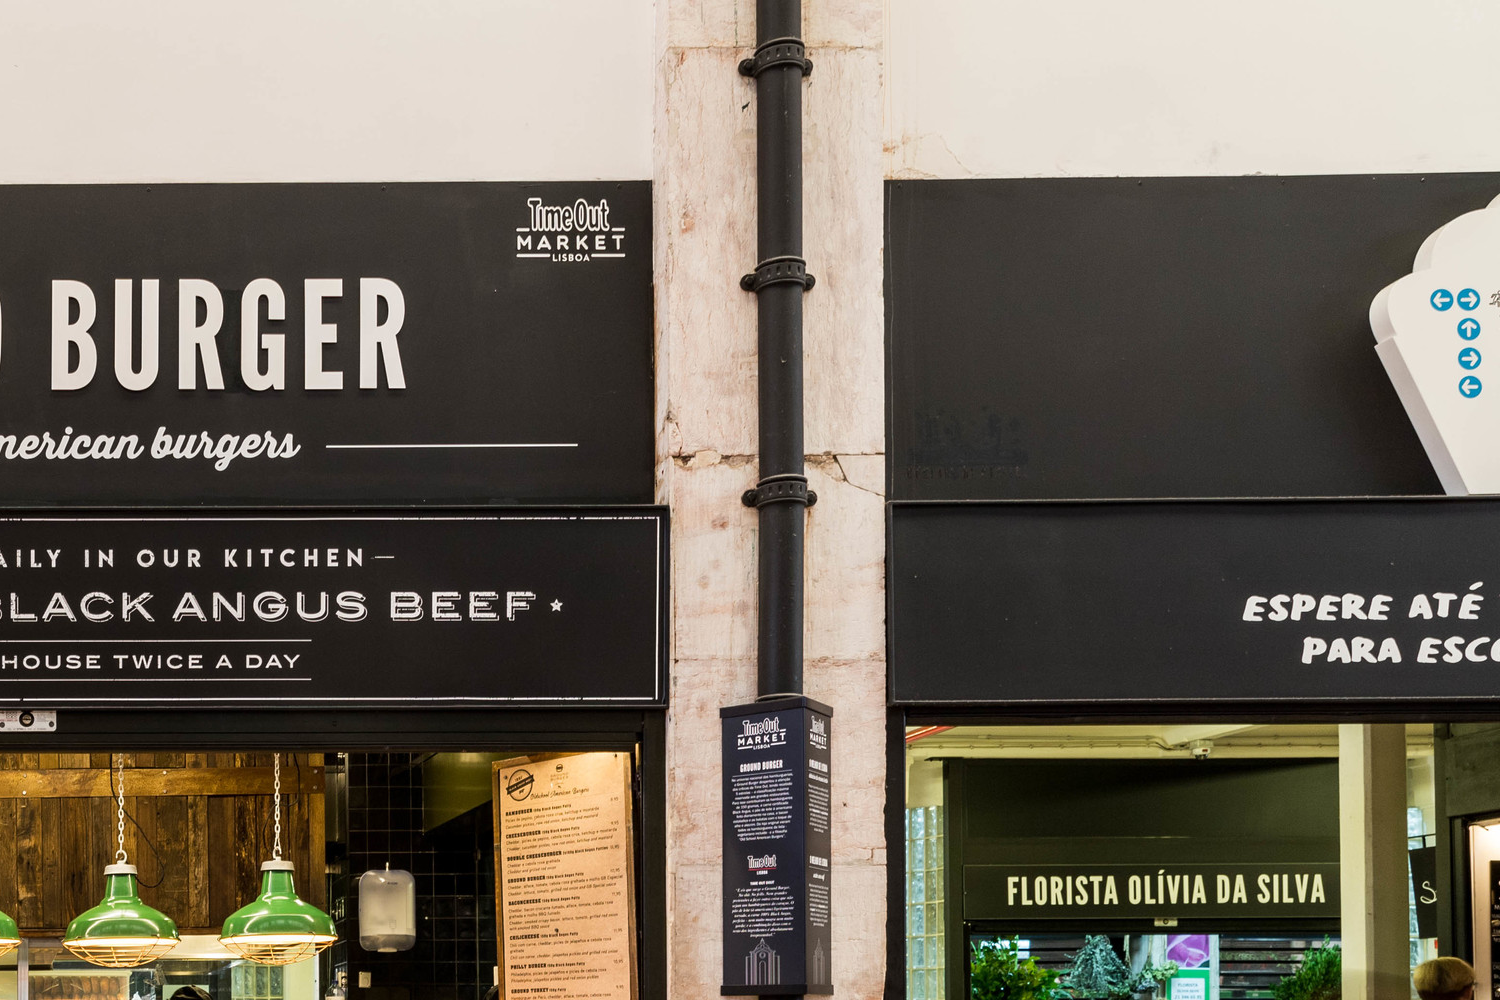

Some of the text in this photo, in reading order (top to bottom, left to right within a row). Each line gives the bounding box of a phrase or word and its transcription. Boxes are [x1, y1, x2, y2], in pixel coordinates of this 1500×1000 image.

[516, 235, 625, 251] MARKET
[552, 254, 591, 262] LISBOA
[50, 276, 407, 392] BURGER
[148, 426, 302, 472] burgers
[84, 549, 115, 568] IN
[136, 549, 202, 568] OUR
[224, 548, 364, 568] KITCHEN
[172, 590, 368, 622] ANGUS
[389, 591, 537, 622] BEEF
[1242, 581, 1484, 622] ESPERE ATÉ
[0, 653, 101, 670] HOUSE
[113, 653, 204, 670] TWICE
[215, 653, 234, 669] A
[245, 653, 301, 669] DAY
[1301, 636, 1402, 664] PARA
[737, 732, 787, 747] MARKET
[740, 759, 784, 773] GROUND BURGER
[1007, 869, 1326, 906] FLORISTA OLÍVIA DA SILVA
